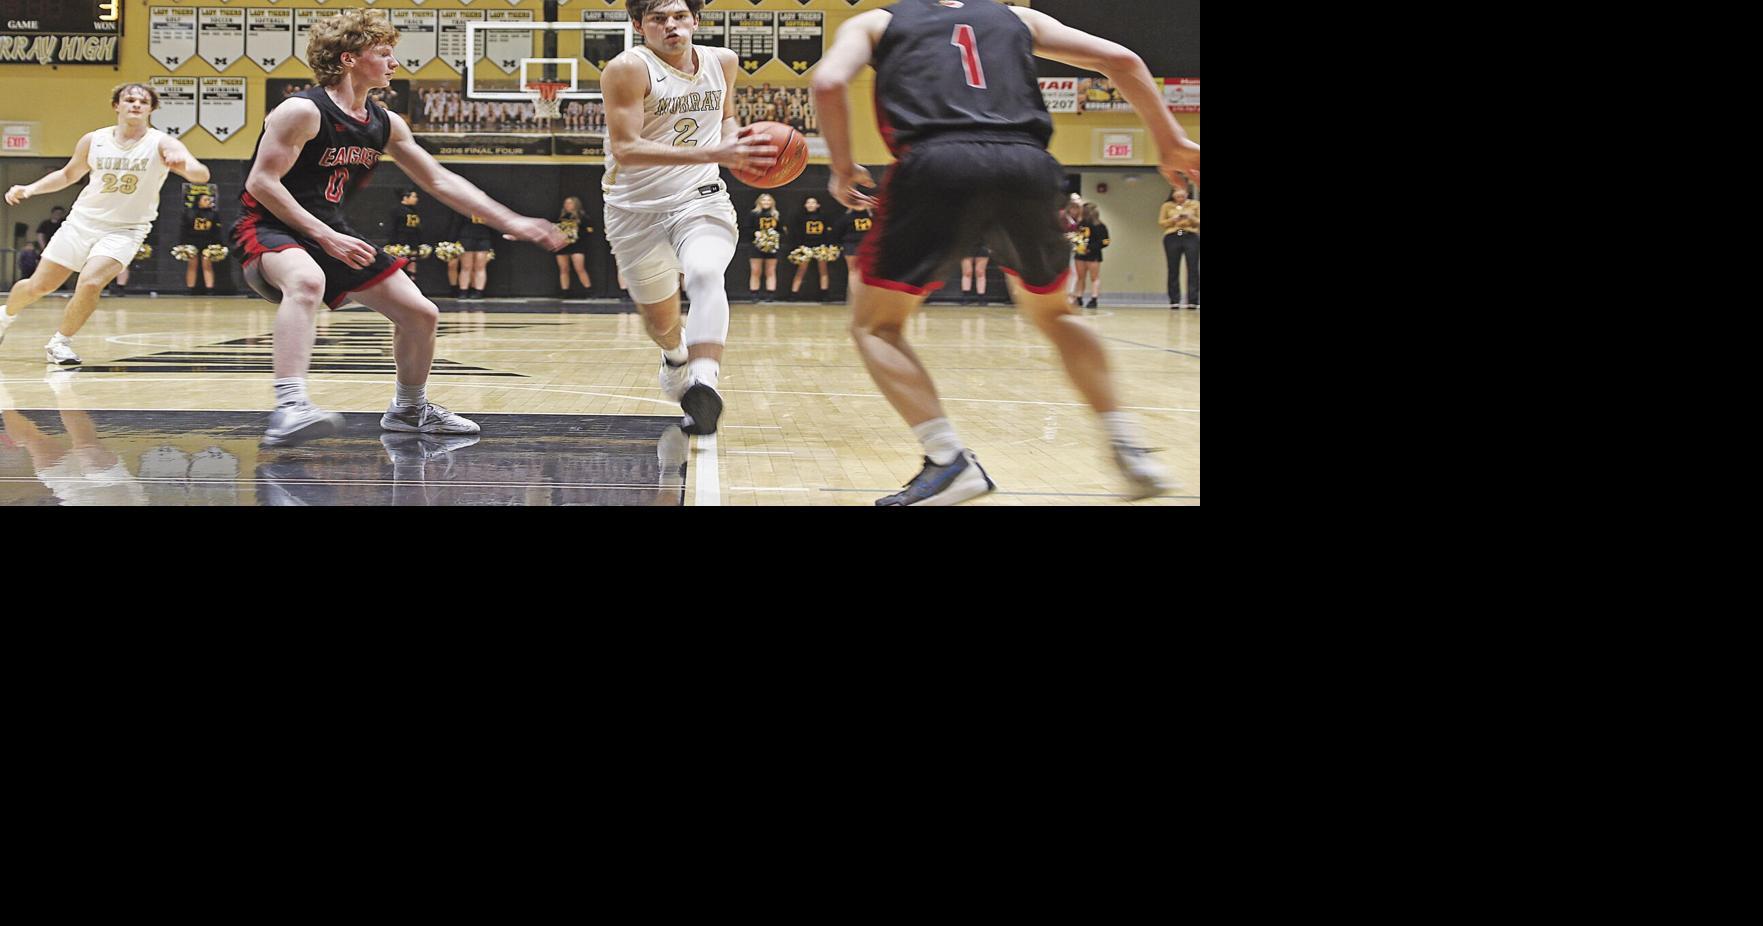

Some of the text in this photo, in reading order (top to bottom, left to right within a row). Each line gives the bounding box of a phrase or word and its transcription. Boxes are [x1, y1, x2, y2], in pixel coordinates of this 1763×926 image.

[99, 0, 119, 21] 3
[7, 20, 39, 30] GAME
[93, 21, 117, 31] WON
[59, 35, 117, 61] HIGH
[950, 23, 988, 89] 1
[654, 90, 722, 116] MURRAY
[7, 136, 27, 148] EXIT
[672, 117, 699, 147] 2
[439, 147, 524, 155] 2016 FINAL FOUR
[100, 173, 139, 194] 23
[325, 168, 349, 203] 0
